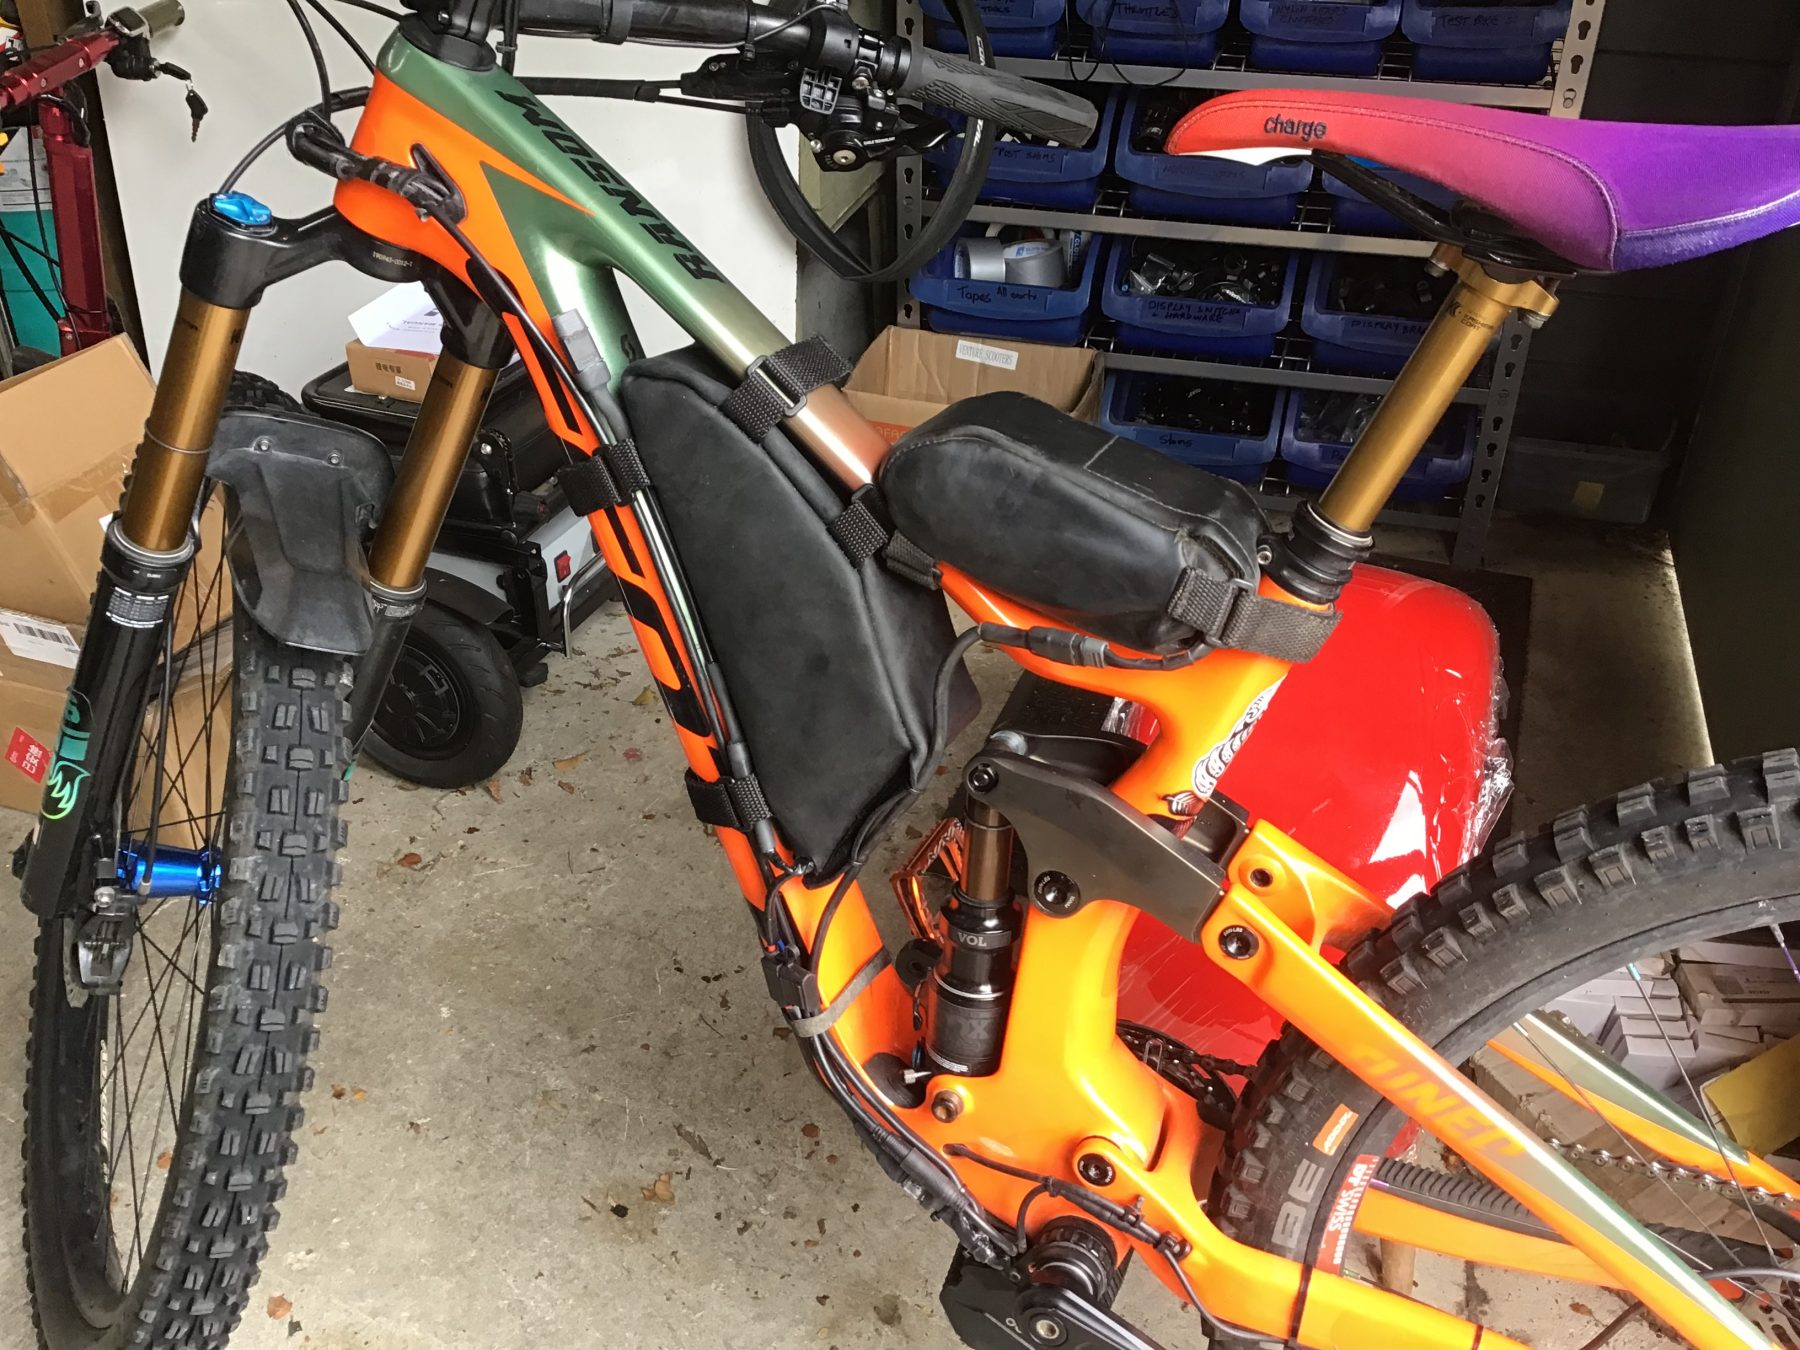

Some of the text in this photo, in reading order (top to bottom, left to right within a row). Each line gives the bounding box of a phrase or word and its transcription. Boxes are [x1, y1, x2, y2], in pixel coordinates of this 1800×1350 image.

[1263, 113, 1328, 142] charge
[494, 89, 726, 284] RANSOM
[956, 285, 992, 304] Tapes
[1328, 1163, 1368, 1232] DT SWISS
